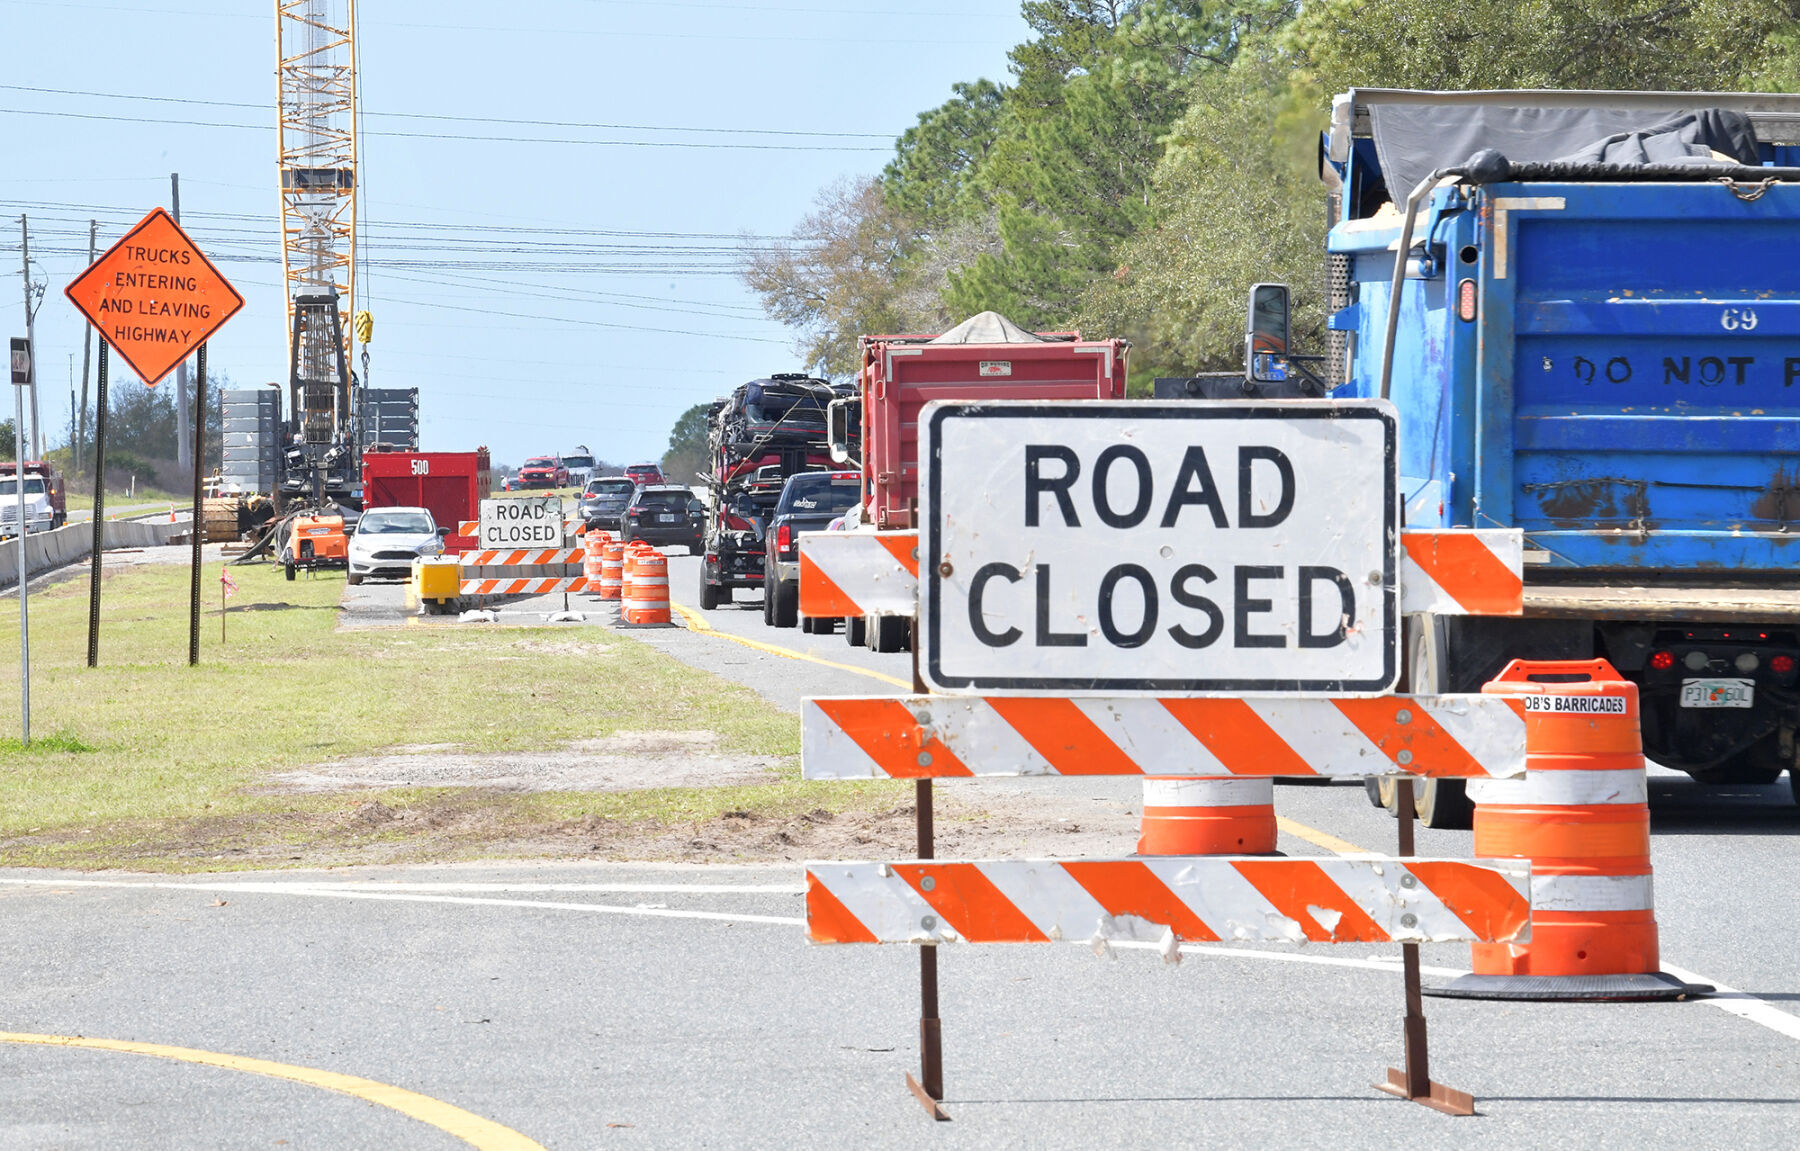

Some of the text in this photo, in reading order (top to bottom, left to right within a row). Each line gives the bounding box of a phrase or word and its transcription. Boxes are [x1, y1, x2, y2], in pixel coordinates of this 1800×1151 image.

[125, 245, 191, 265] TRUCKS
[115, 271, 197, 292] ENTERING
[98, 298, 210, 319] AND LEAVING
[1720, 307, 1759, 331] 69
[114, 325, 192, 344] HIGHWAY
[1573, 355, 1632, 385] DO
[1663, 355, 1755, 387] NOT
[411, 459, 429, 475] 500
[1024, 443, 1296, 530] ROAD
[496, 504, 545, 520] ROAD
[488, 525, 556, 542] CLOSED
[967, 561, 1357, 650] CLOSED
[1525, 696, 1624, 713] OB'S BARRICADES
